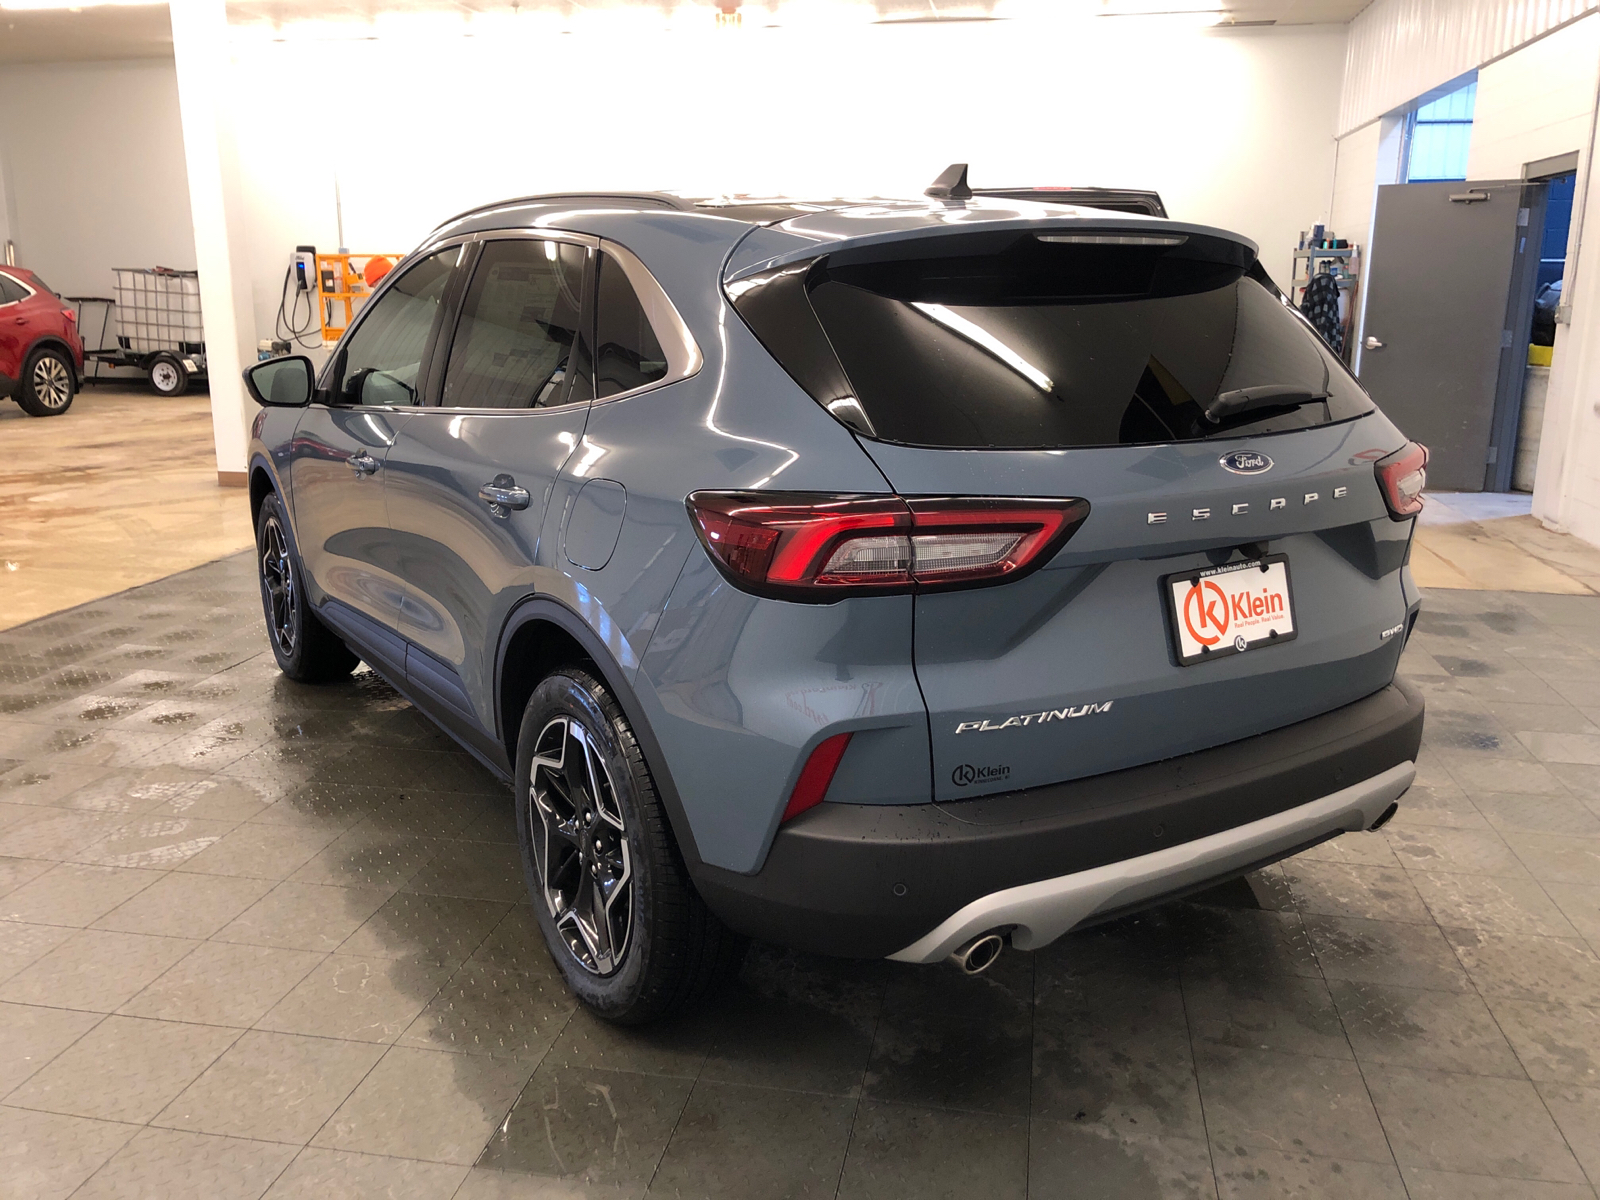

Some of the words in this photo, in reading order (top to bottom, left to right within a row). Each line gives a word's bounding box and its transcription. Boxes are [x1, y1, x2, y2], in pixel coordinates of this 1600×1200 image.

[1235, 454, 1264, 469] Ford
[1147, 486, 1348, 525] ESCAPE
[1199, 560, 1261, 577] www.kleinauto.com
[1230, 588, 1284, 621] Klein
[955, 700, 1114, 734] PLATINUM
[977, 764, 1011, 778] Klein
